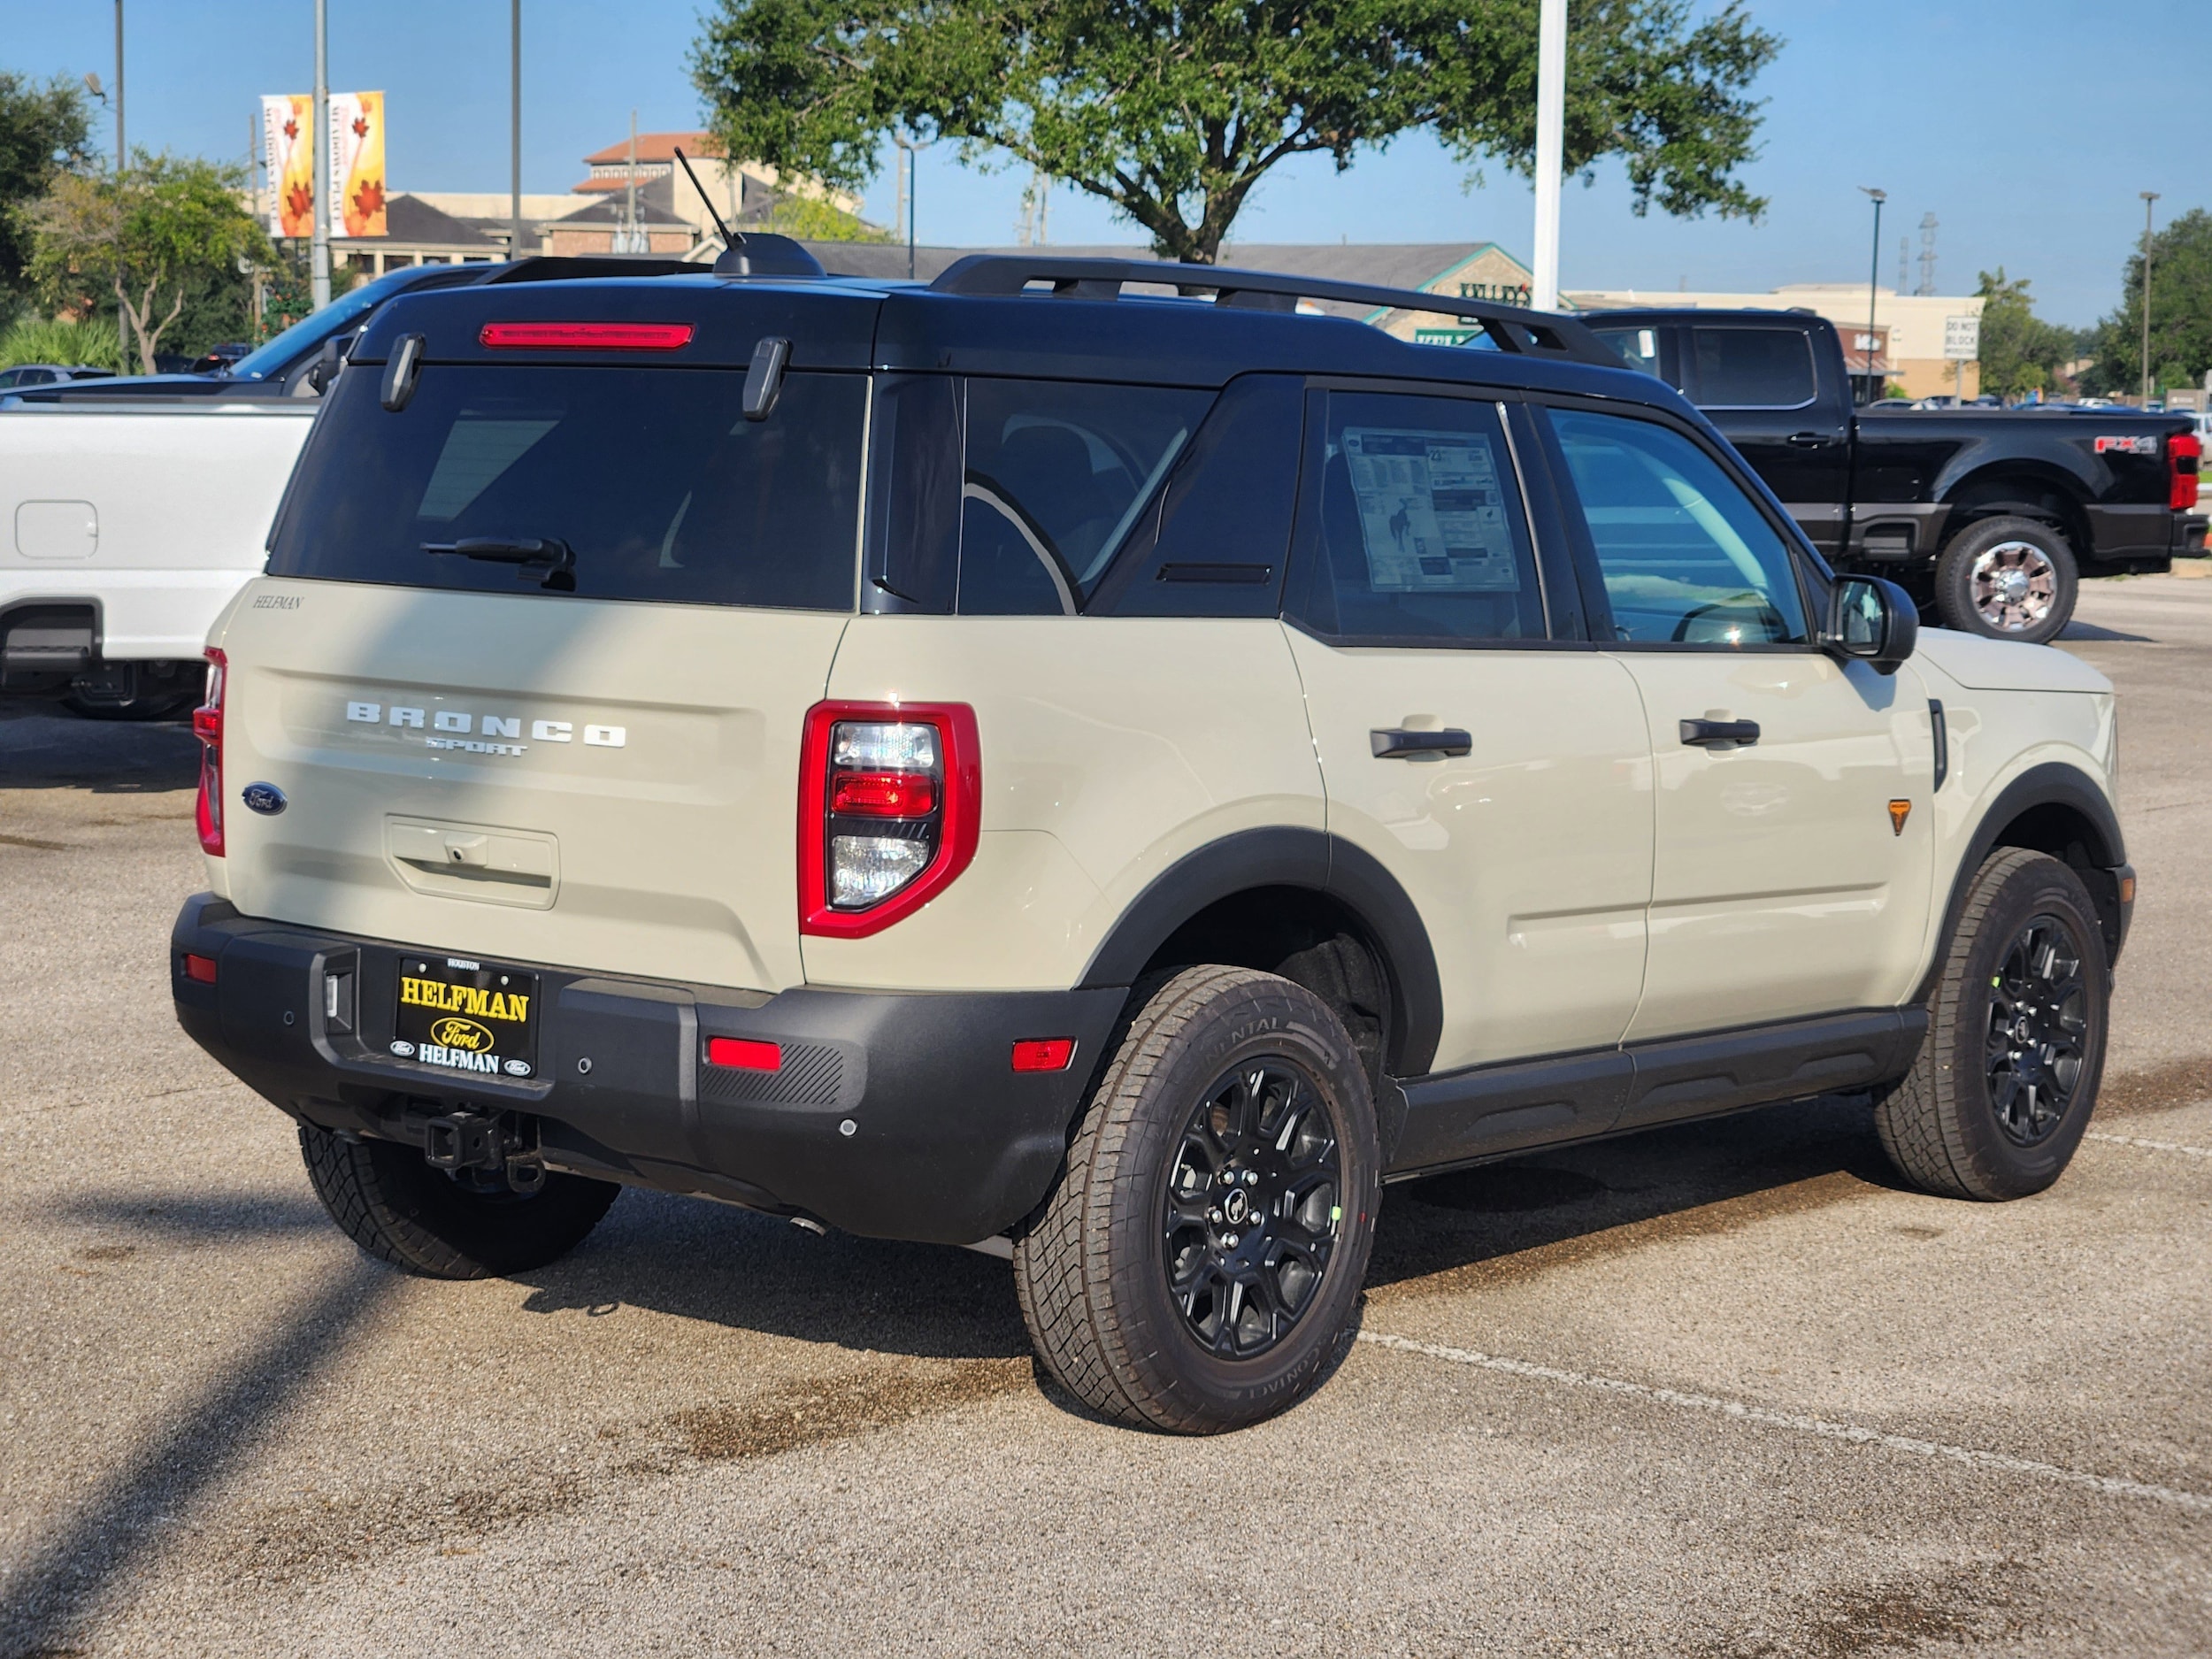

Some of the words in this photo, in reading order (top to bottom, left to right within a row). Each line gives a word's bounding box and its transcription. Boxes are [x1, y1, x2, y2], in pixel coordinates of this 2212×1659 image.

[331, 106, 342, 177] MEADOWS
[332, 180, 342, 220] PLACE
[2094, 435, 2157, 454] FX4
[253, 595, 304, 610] HELFMAN
[346, 701, 626, 748] BRONCO
[426, 736, 528, 757] SPORT
[249, 788, 274, 809] Ford
[447, 957, 480, 972] HOUSTON
[400, 976, 530, 1023] HELFMAN
[441, 1019, 482, 1050] Ford
[419, 1042, 501, 1074] HELFMAN
